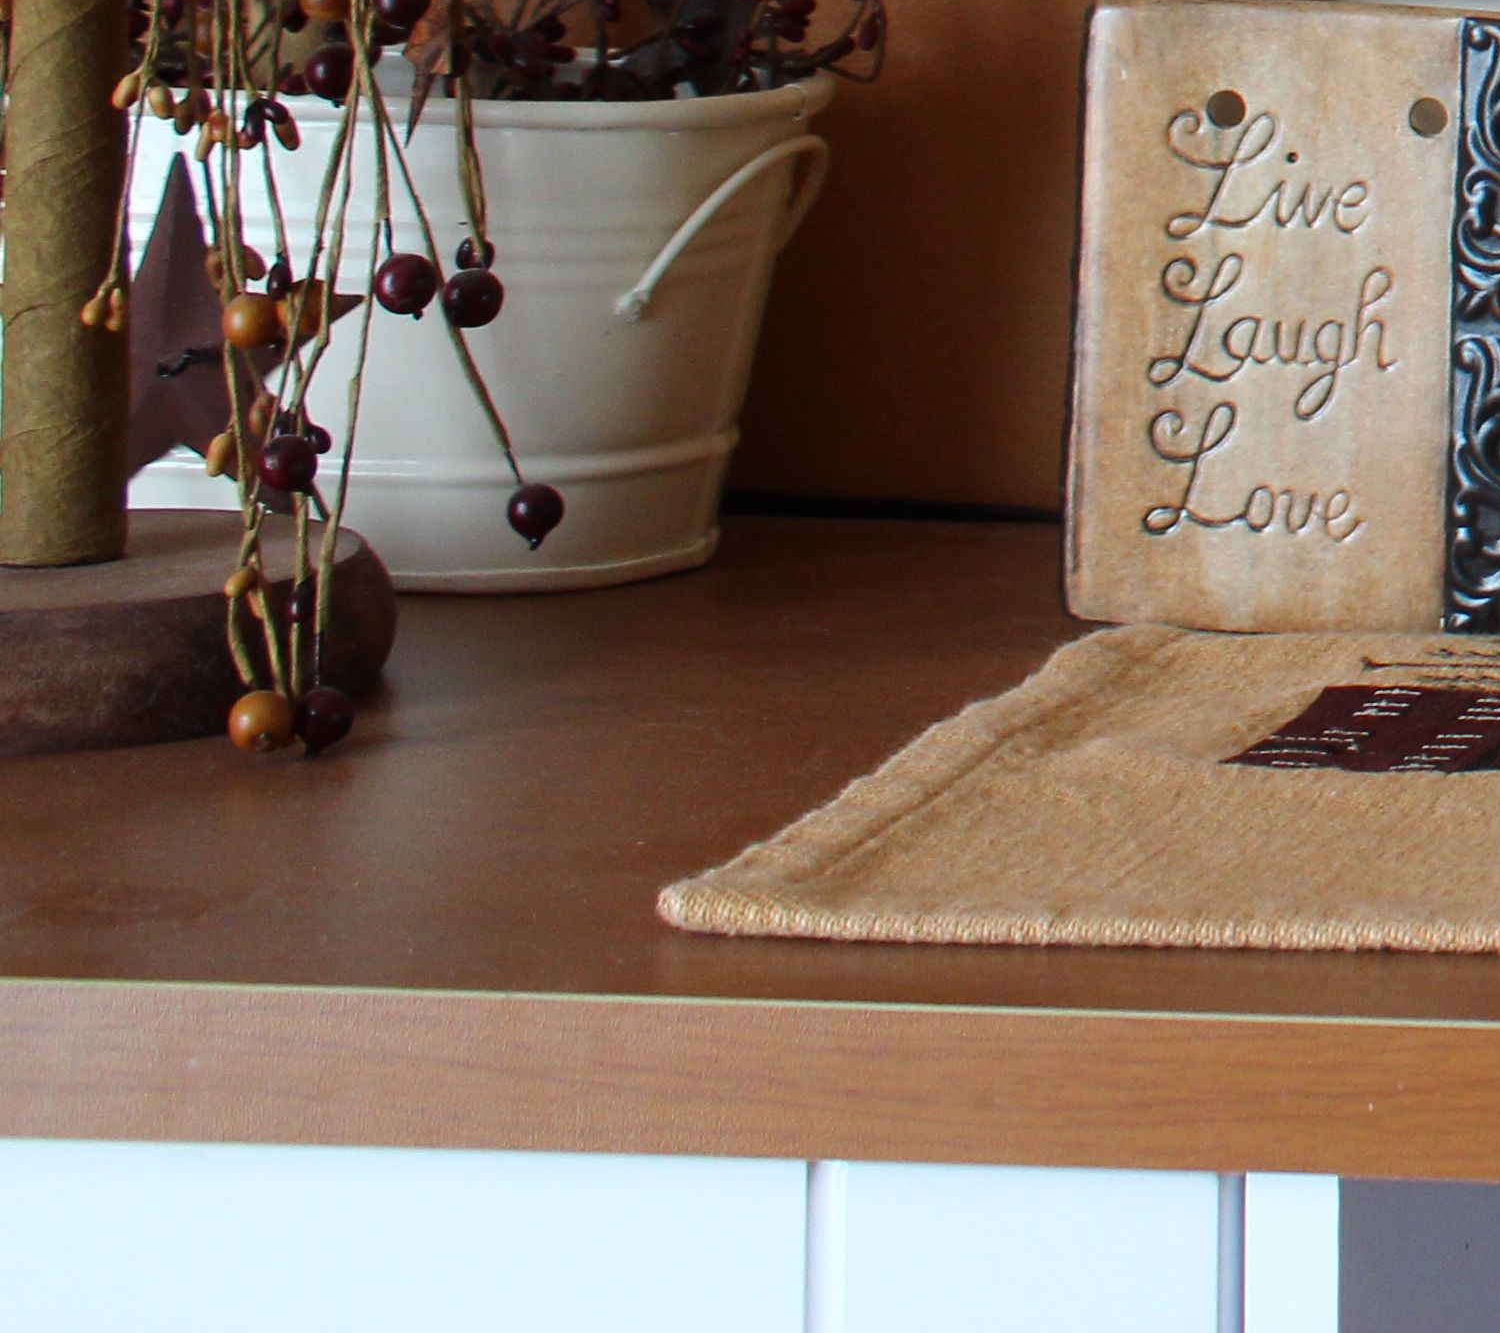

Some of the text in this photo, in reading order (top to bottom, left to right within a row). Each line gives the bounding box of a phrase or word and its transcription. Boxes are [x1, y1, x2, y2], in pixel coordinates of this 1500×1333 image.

[1165, 107, 1371, 240] Live
[1146, 252, 1396, 421] Laugh
[1141, 401, 1363, 543] Love
